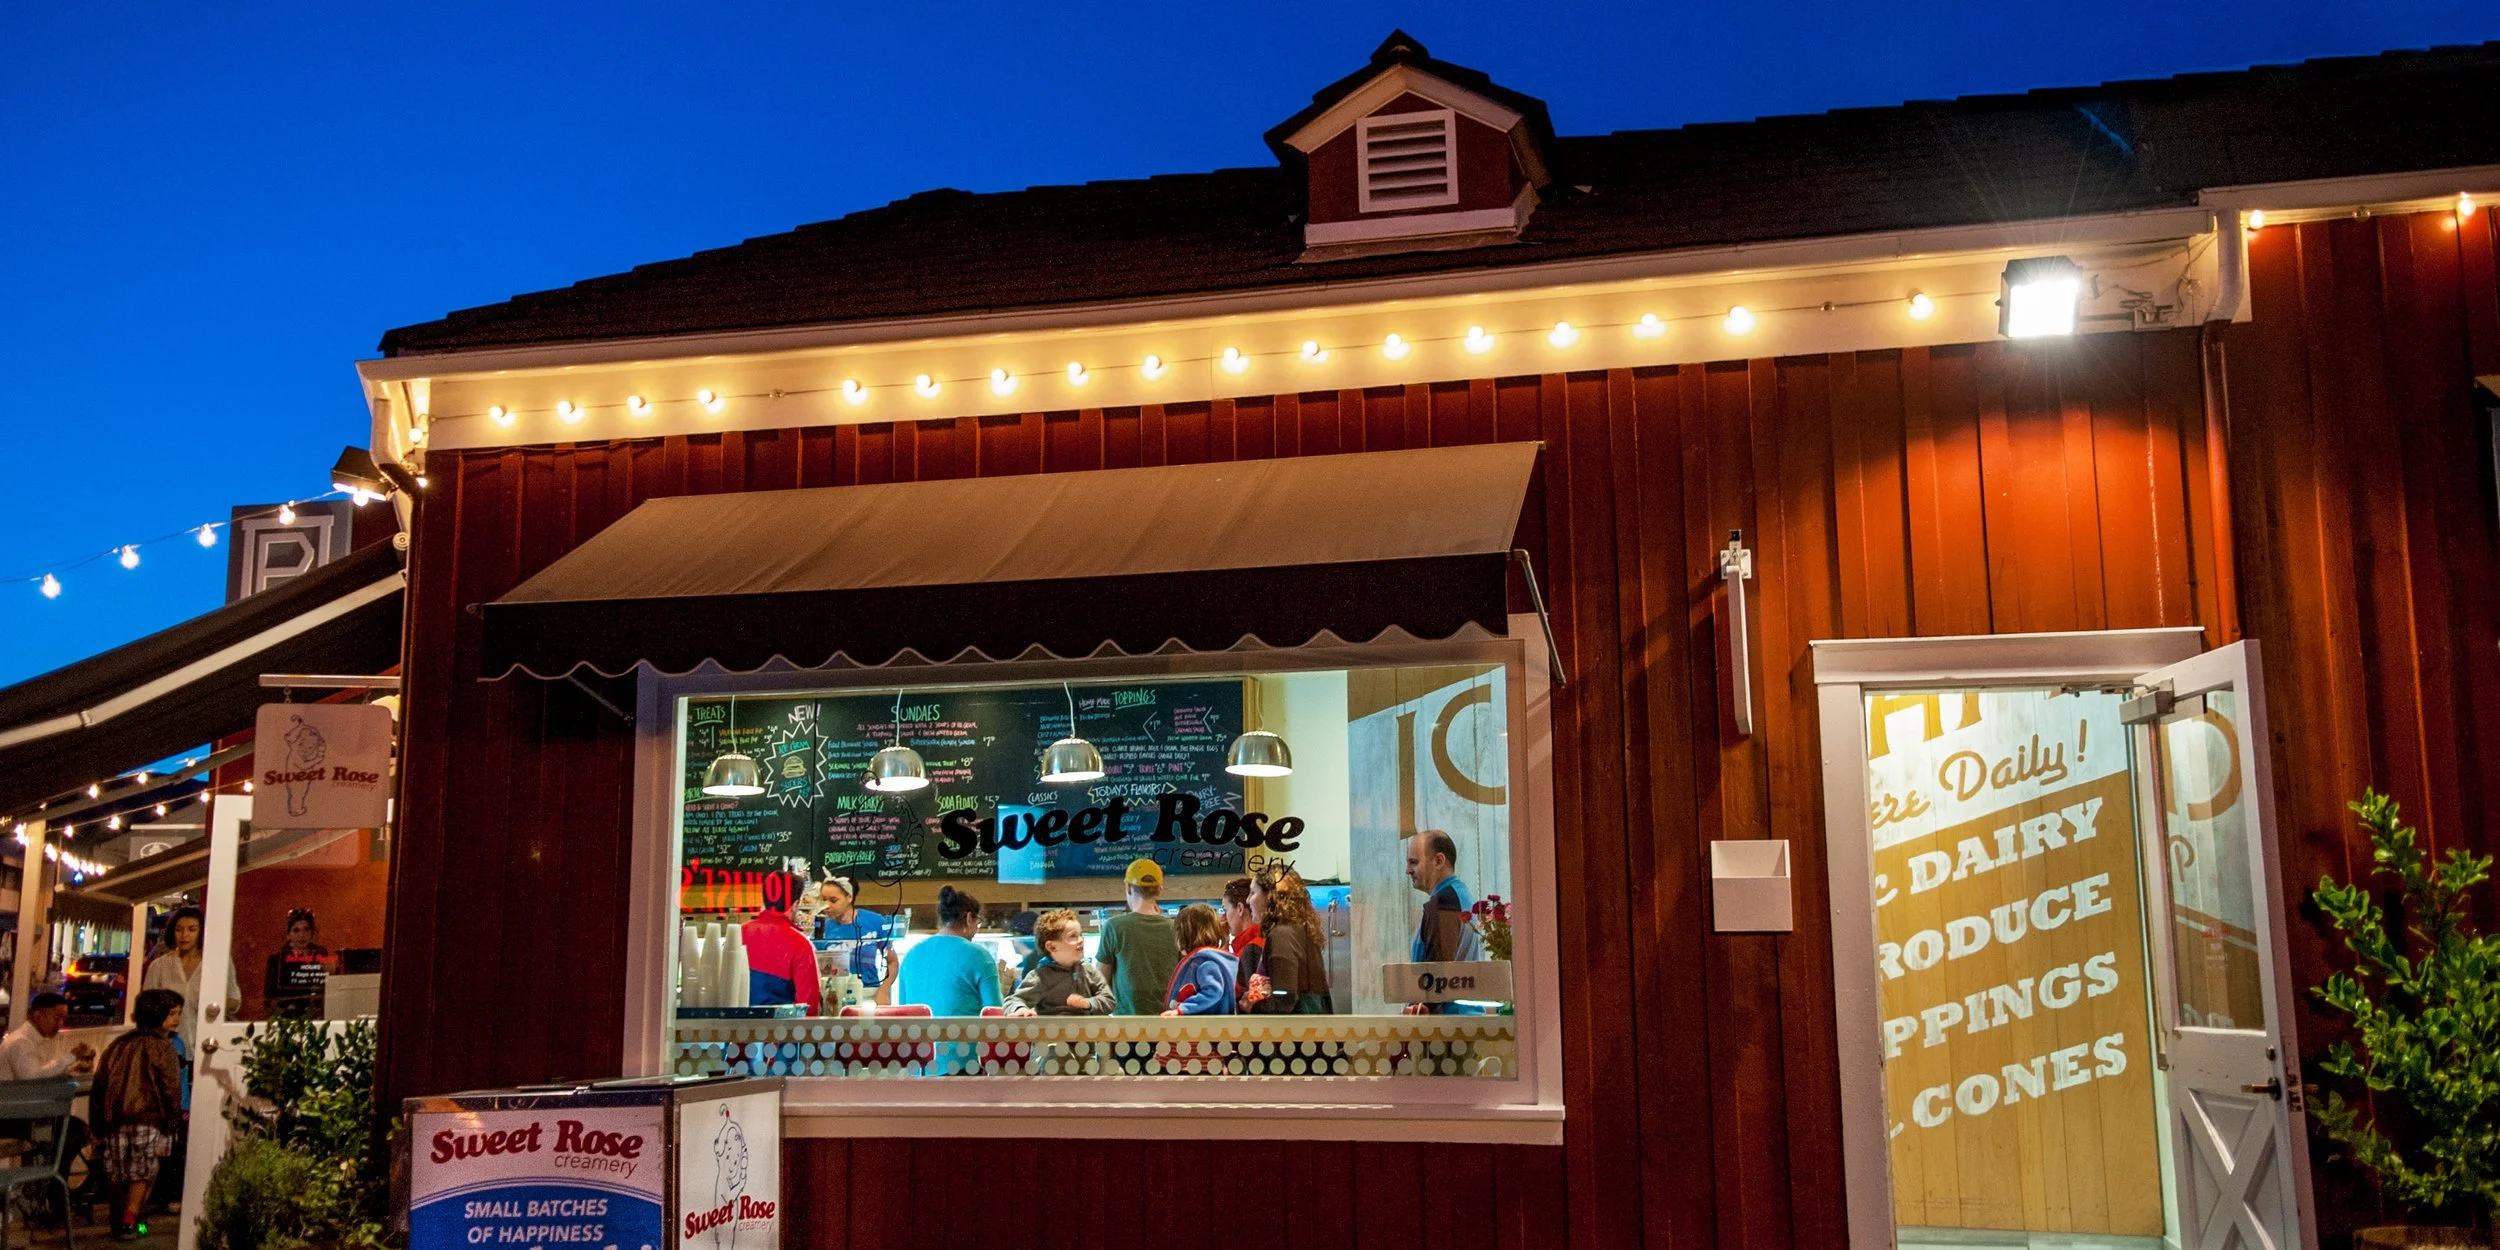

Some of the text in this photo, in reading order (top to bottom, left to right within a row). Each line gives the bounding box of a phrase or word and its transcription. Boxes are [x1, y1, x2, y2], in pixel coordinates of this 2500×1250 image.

[1111, 688, 1157, 706] TOPPINGS
[695, 705, 726, 721] TREATS
[788, 703, 821, 724] NEW!
[890, 704, 940, 722] SUNDAES
[264, 766, 380, 785] Sweet Rose
[1939, 734, 2068, 802] Daily
[1028, 791, 1058, 804] CLASSICS
[1092, 782, 1166, 797] TODAY'S FLAVORS!
[837, 795, 857, 810] MILK
[858, 794, 885, 811] SHAKES
[936, 796, 955, 812] SODA
[956, 795, 979, 810] FLOATS
[937, 796, 1130, 860] Sweet
[1151, 792, 1304, 853] Rose
[1908, 797, 2103, 895] DAIRY
[1152, 847, 1297, 884] creamery
[1879, 872, 2112, 980] RODUCE
[1417, 972, 1476, 993] Open
[1883, 951, 2119, 1060] PPINGS
[1912, 1032, 2128, 1128] CONES
[431, 1119, 644, 1164] Sweet Rose
[554, 1155, 639, 1180] creamery
[464, 1198, 608, 1219] SMALL BATCHES
[684, 1194, 775, 1239] Sweet Rose
[467, 1224, 604, 1244] OF HAPPINESS
[738, 1219, 774, 1234] creamery
